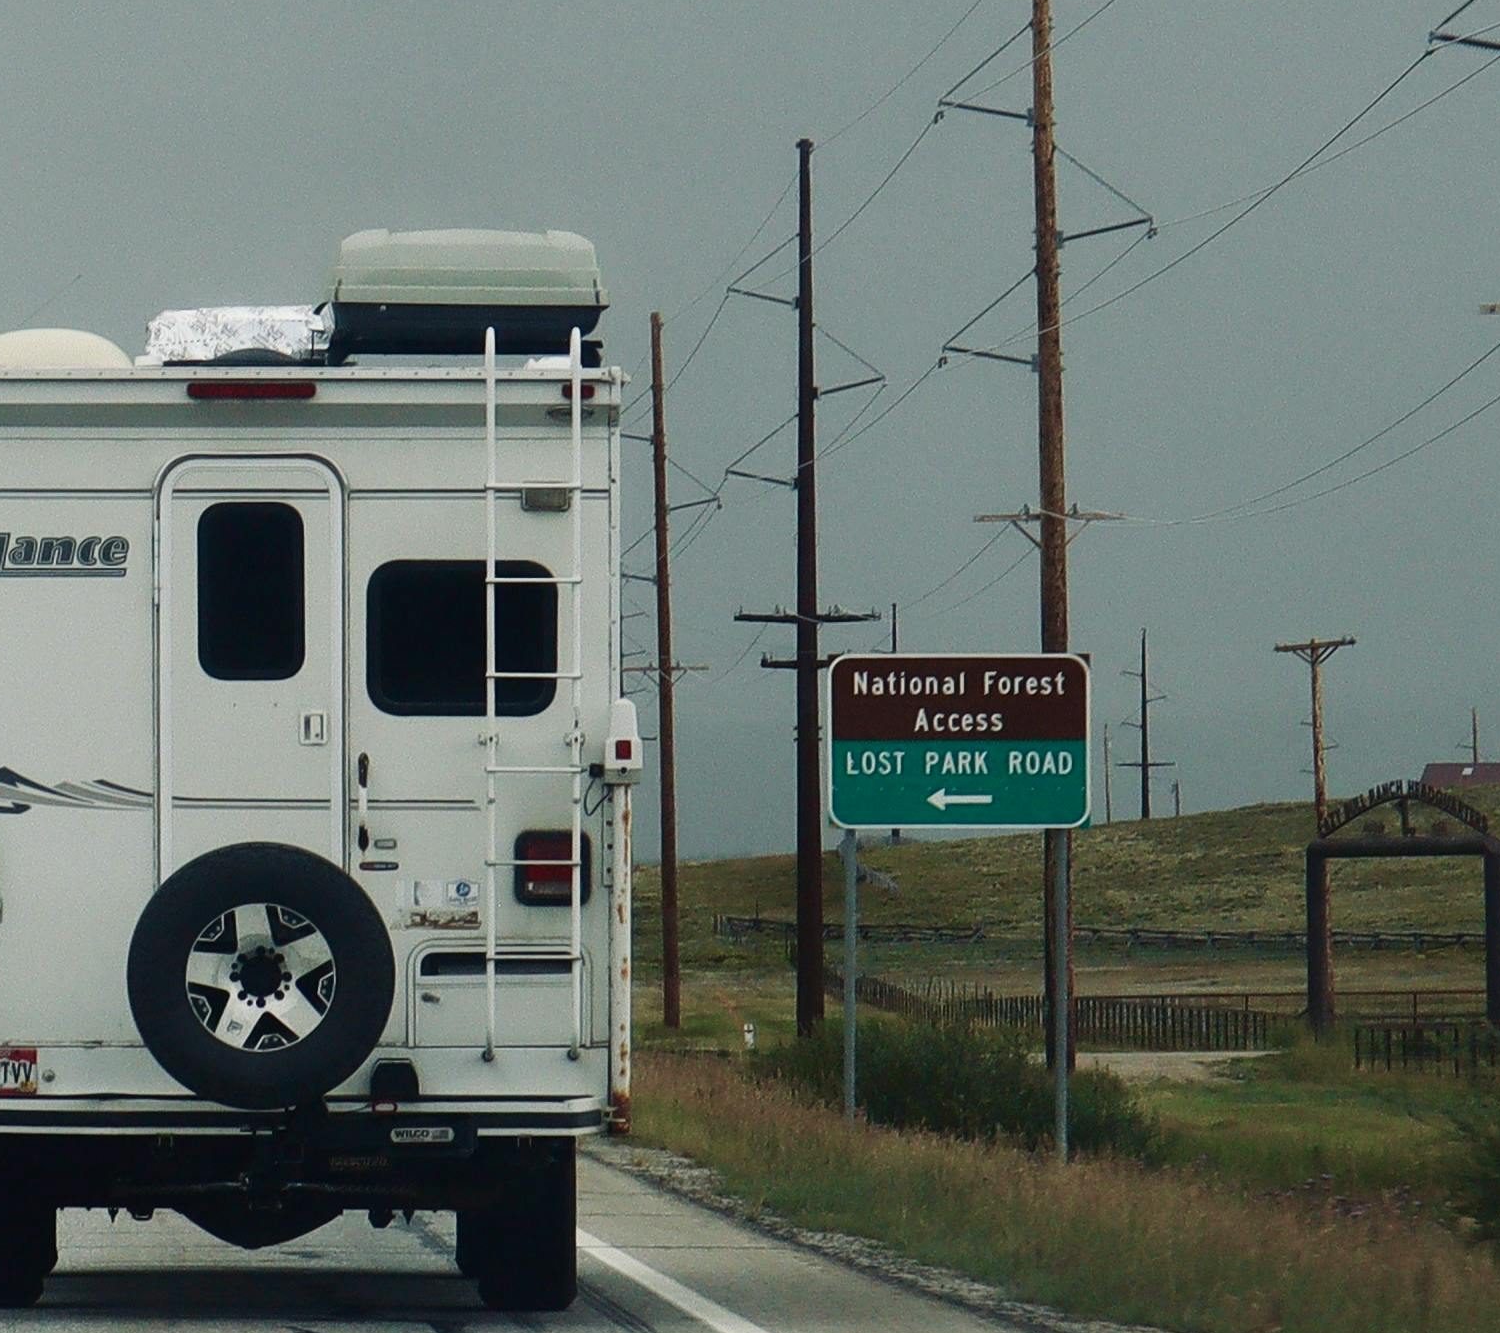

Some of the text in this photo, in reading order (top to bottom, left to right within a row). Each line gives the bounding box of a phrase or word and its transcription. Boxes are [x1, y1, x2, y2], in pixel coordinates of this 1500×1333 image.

[853, 670, 1066, 696] National Forest
[914, 708, 1004, 732] Access
[846, 751, 1073, 775] LOST PARK ROAD
[1368, 779, 1403, 805] RANCH
[0, 1060, 33, 1084] TVV
[393, 1129, 430, 1138] WILCO
